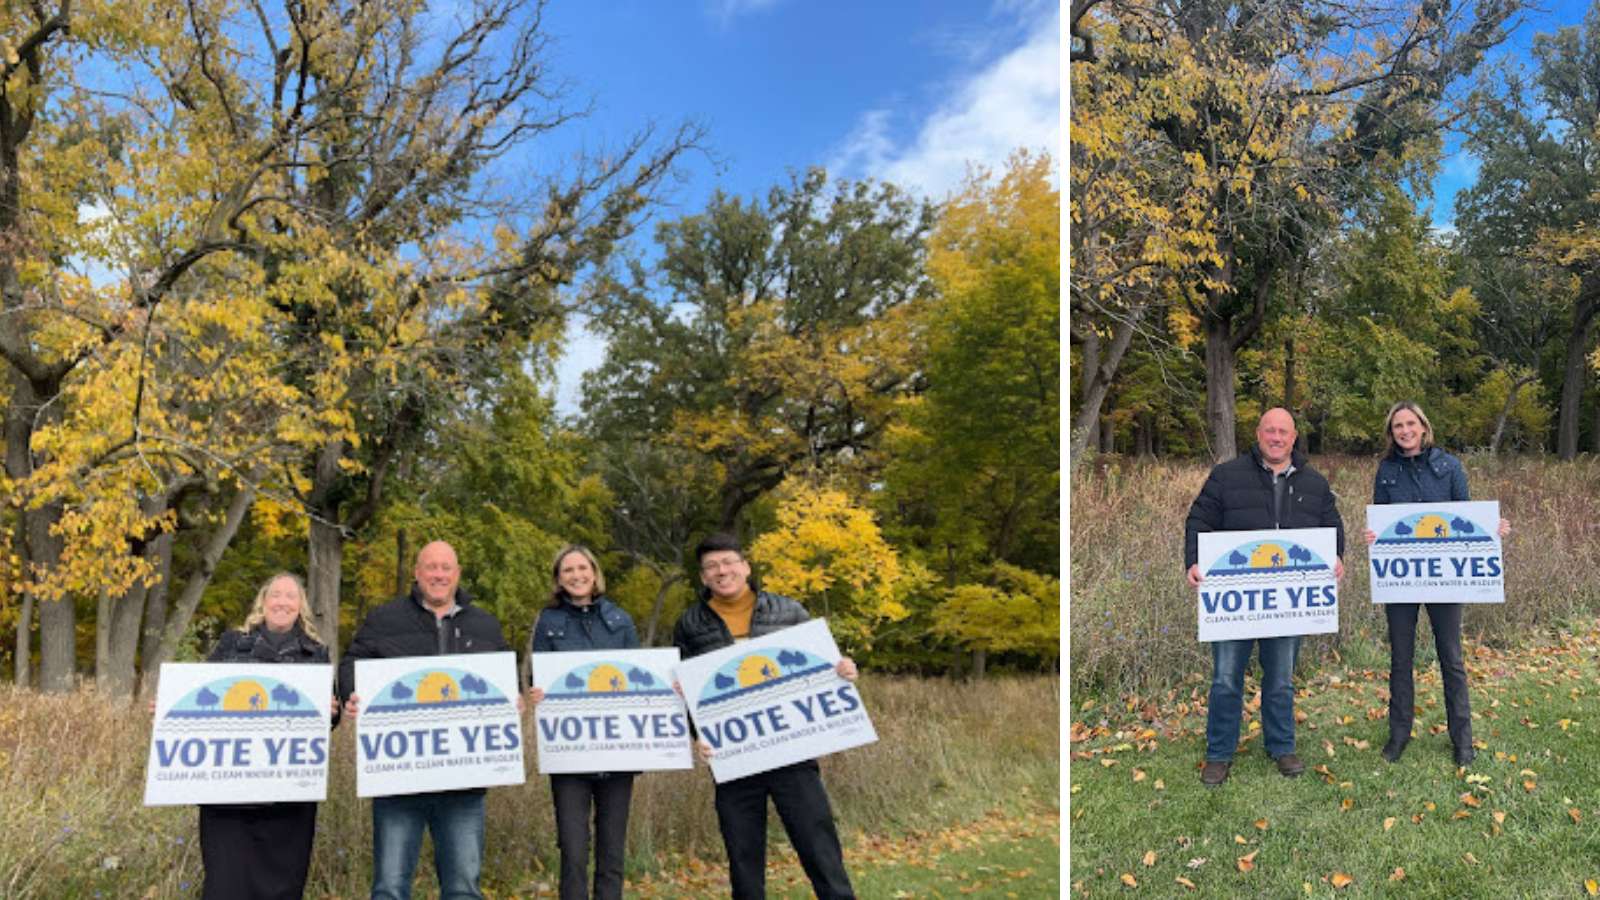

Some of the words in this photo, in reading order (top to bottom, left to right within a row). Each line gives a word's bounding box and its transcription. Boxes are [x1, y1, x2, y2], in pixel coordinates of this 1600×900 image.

[1372, 558, 1443, 578] VOTE
[1449, 557, 1501, 577] YES
[1201, 588, 1277, 614] VOTE
[1286, 585, 1336, 608] YES
[539, 715, 620, 741] VOTE
[628, 713, 686, 739] YES
[701, 705, 790, 749] VOTE
[792, 685, 858, 722] YES
[155, 738, 252, 767] VOTE
[263, 737, 326, 765] YES
[360, 728, 449, 760] VOTE
[460, 723, 519, 753] YES
[277, 770, 282, 778] &
